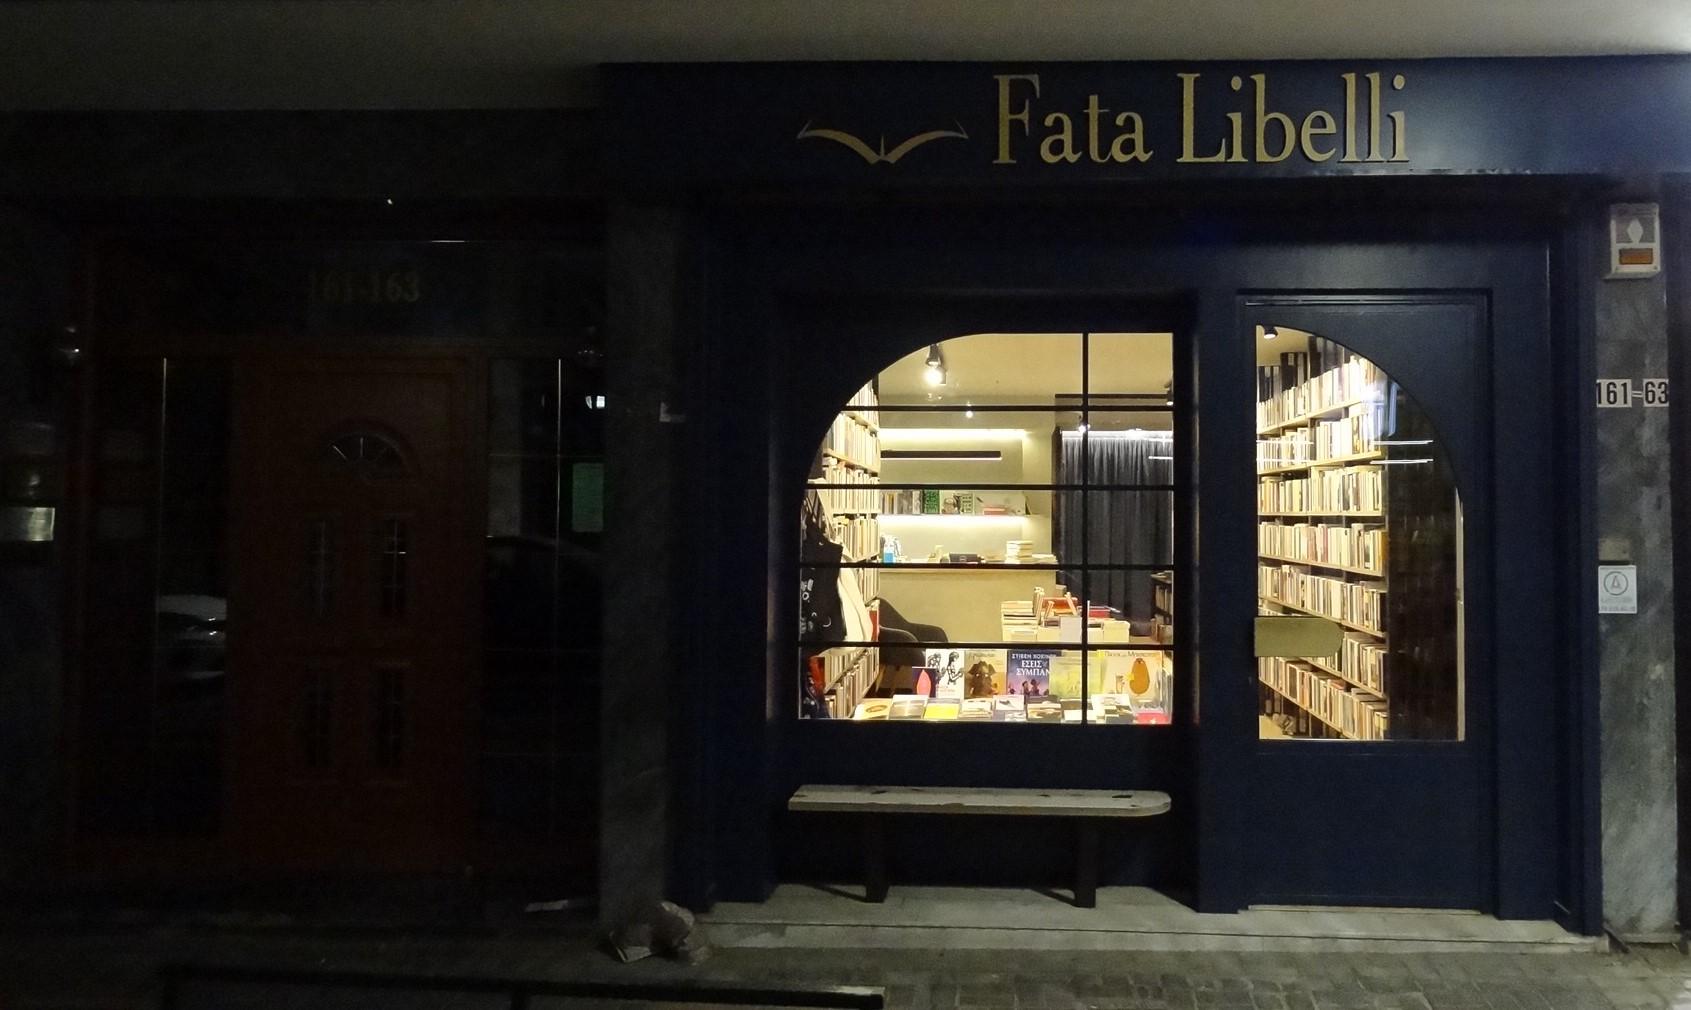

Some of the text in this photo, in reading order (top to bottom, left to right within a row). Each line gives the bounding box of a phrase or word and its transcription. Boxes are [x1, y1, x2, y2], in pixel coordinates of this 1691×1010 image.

[992, 72, 1410, 164] Fata Libelli
[1021, 659, 1043, 668] ΕΣΕΙΣ
